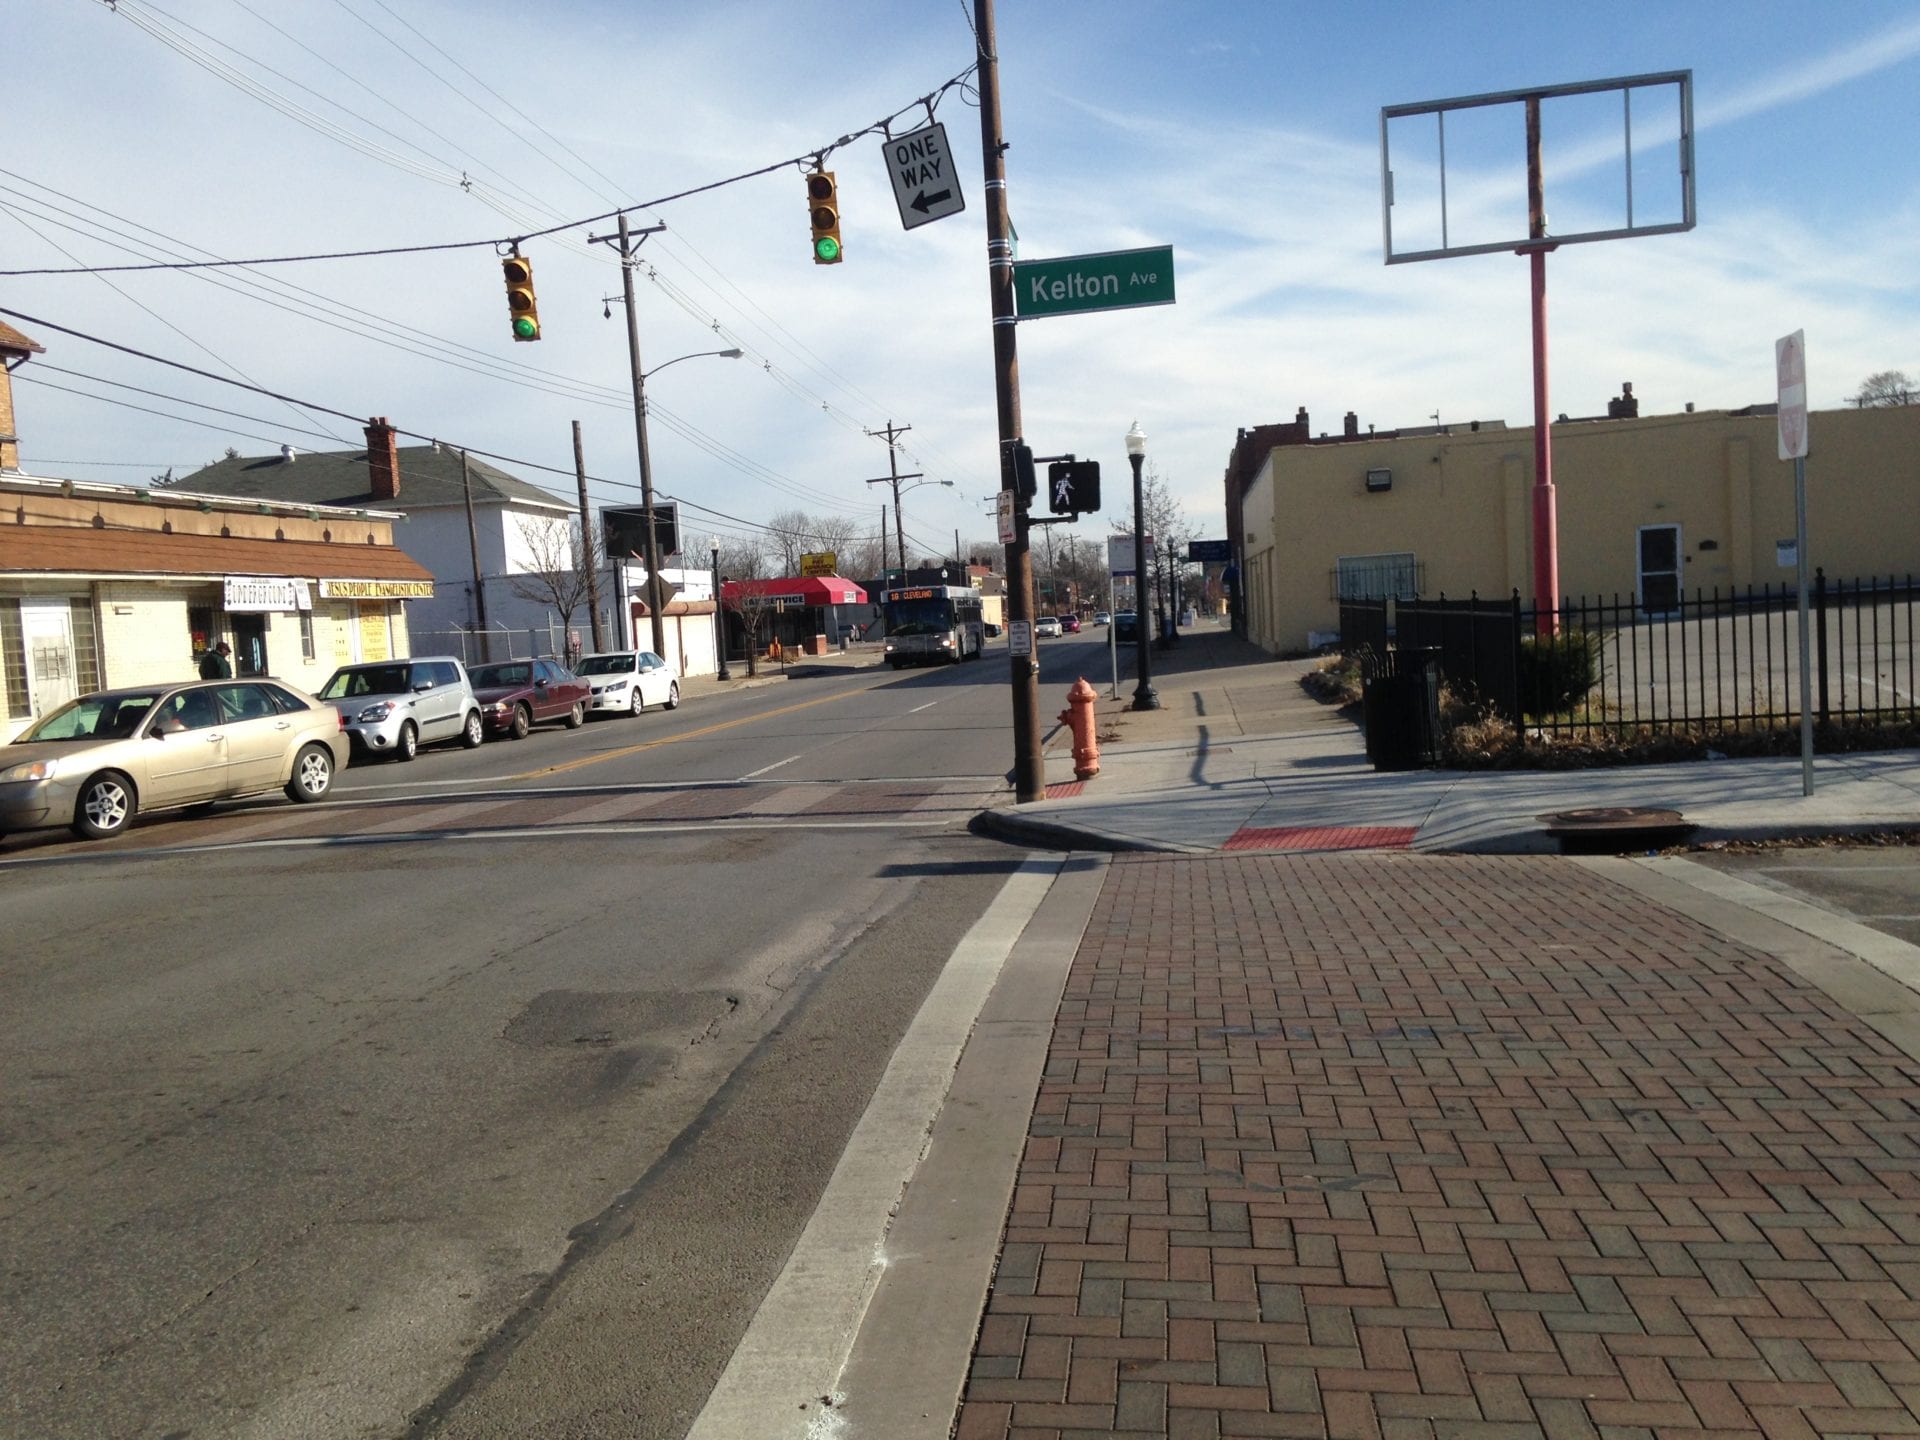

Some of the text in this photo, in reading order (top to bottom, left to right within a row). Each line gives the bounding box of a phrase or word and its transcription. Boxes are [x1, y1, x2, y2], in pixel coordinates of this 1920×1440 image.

[896, 134, 939, 166] ONE
[901, 157, 942, 190] WAY
[1031, 271, 1158, 302] Kelton Ave
[326, 581, 349, 597] JESUS
[349, 582, 372, 597] PEOPLE
[764, 595, 804, 606] SERVICE
[903, 590, 933, 600] CLEVELAND
